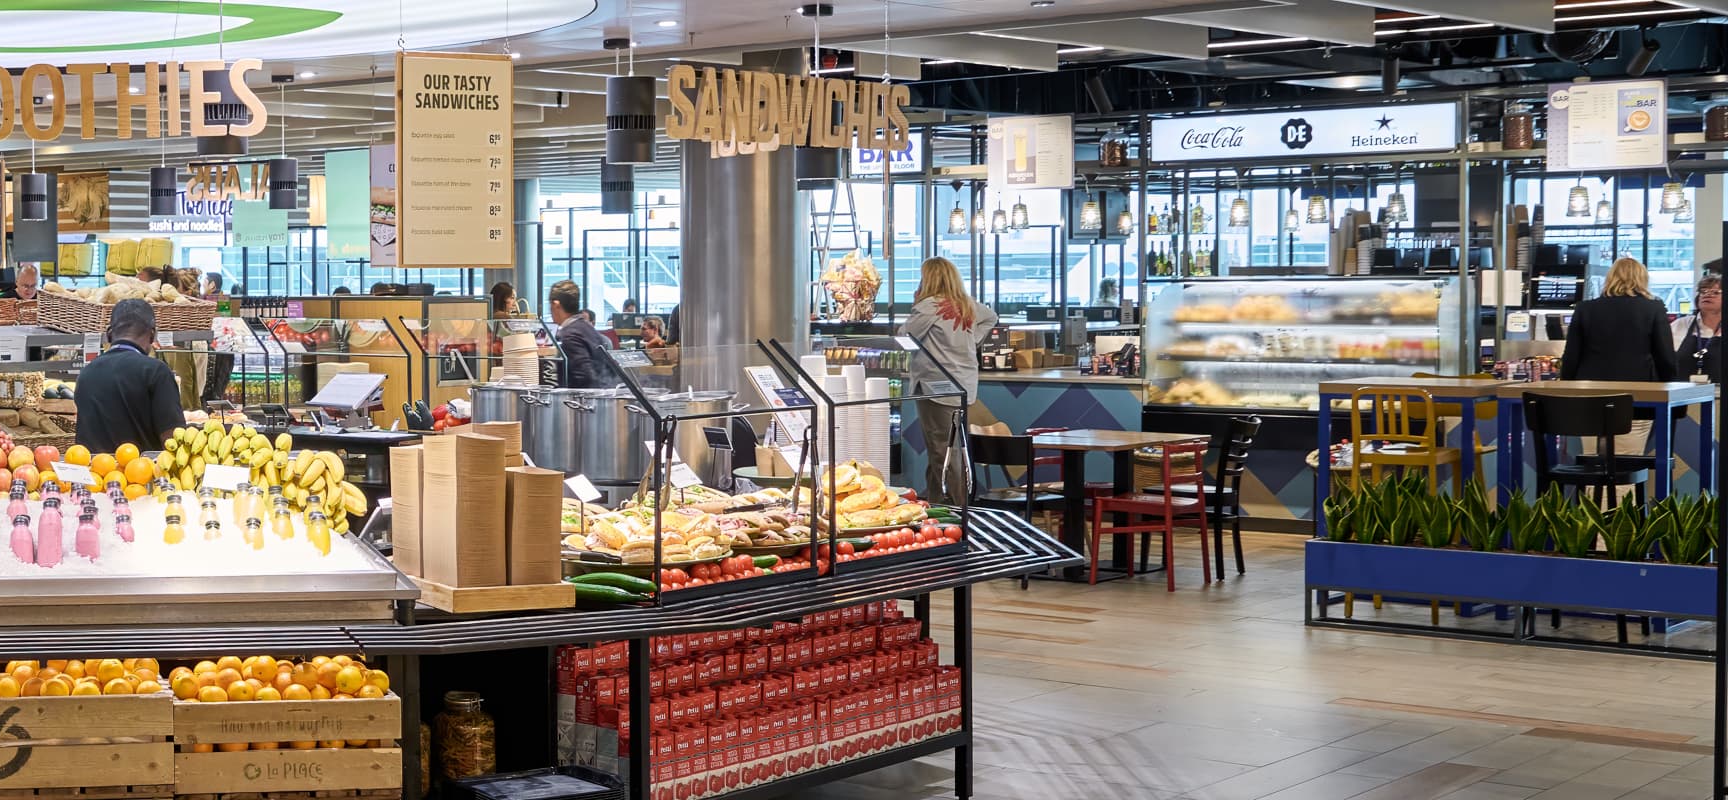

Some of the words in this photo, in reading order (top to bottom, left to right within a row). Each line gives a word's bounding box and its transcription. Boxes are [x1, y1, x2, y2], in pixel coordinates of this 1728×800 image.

[424, 74, 450, 90] OUR
[453, 75, 491, 91] TASTY
[415, 92, 500, 110] SANDWICHES
[665, 65, 911, 150] SANDWICHES
[1636, 99, 1657, 107] BAR
[1351, 134, 1418, 147] Heineken
[149, 219, 172, 232] sushi
[173, 219, 189, 232] and
[190, 219, 223, 232] noodles
[284, 762, 324, 780] PLACE
